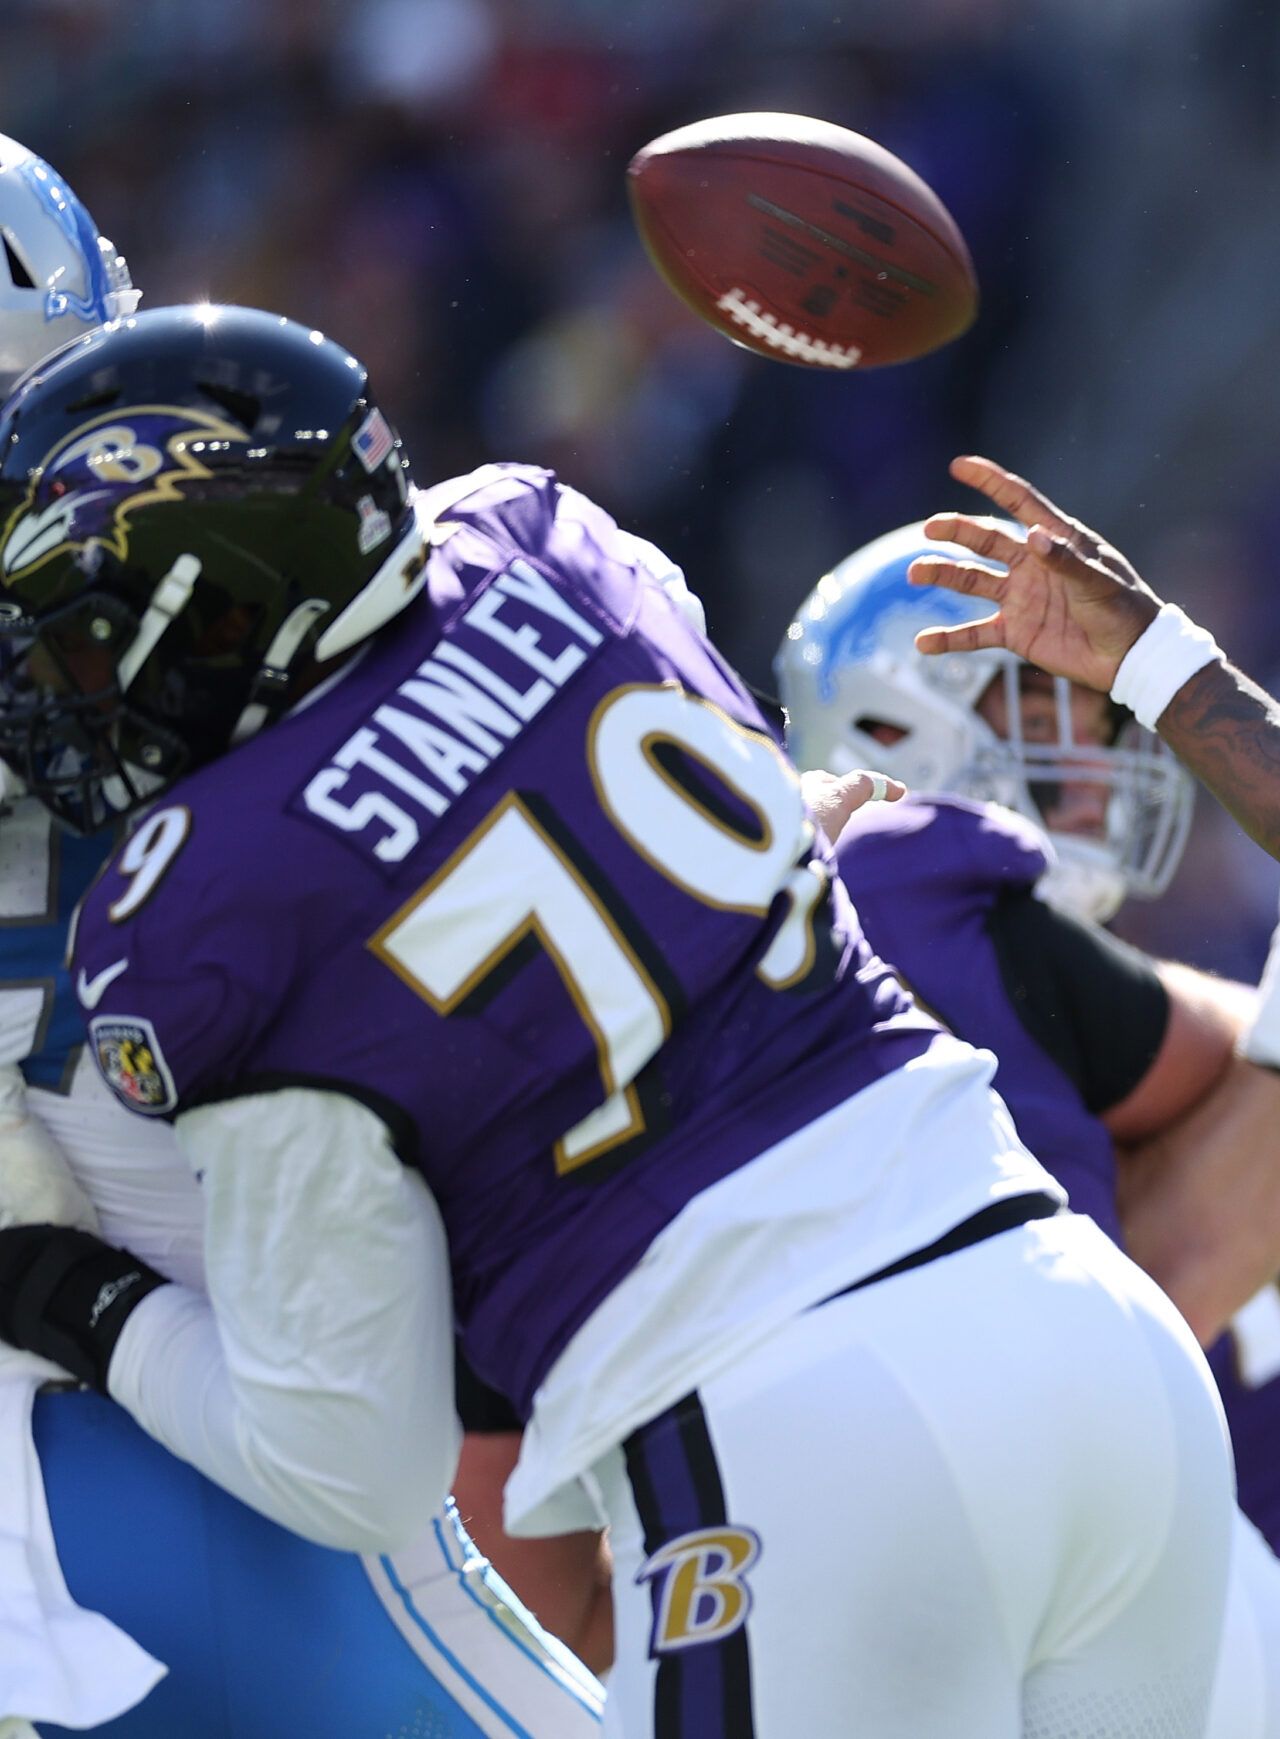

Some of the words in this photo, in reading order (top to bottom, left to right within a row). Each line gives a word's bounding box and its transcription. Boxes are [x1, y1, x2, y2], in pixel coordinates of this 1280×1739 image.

[51, 425, 164, 484] B
[303, 558, 604, 863] STANLEY
[368, 682, 827, 1177] 79
[634, 1524, 763, 1661] B
